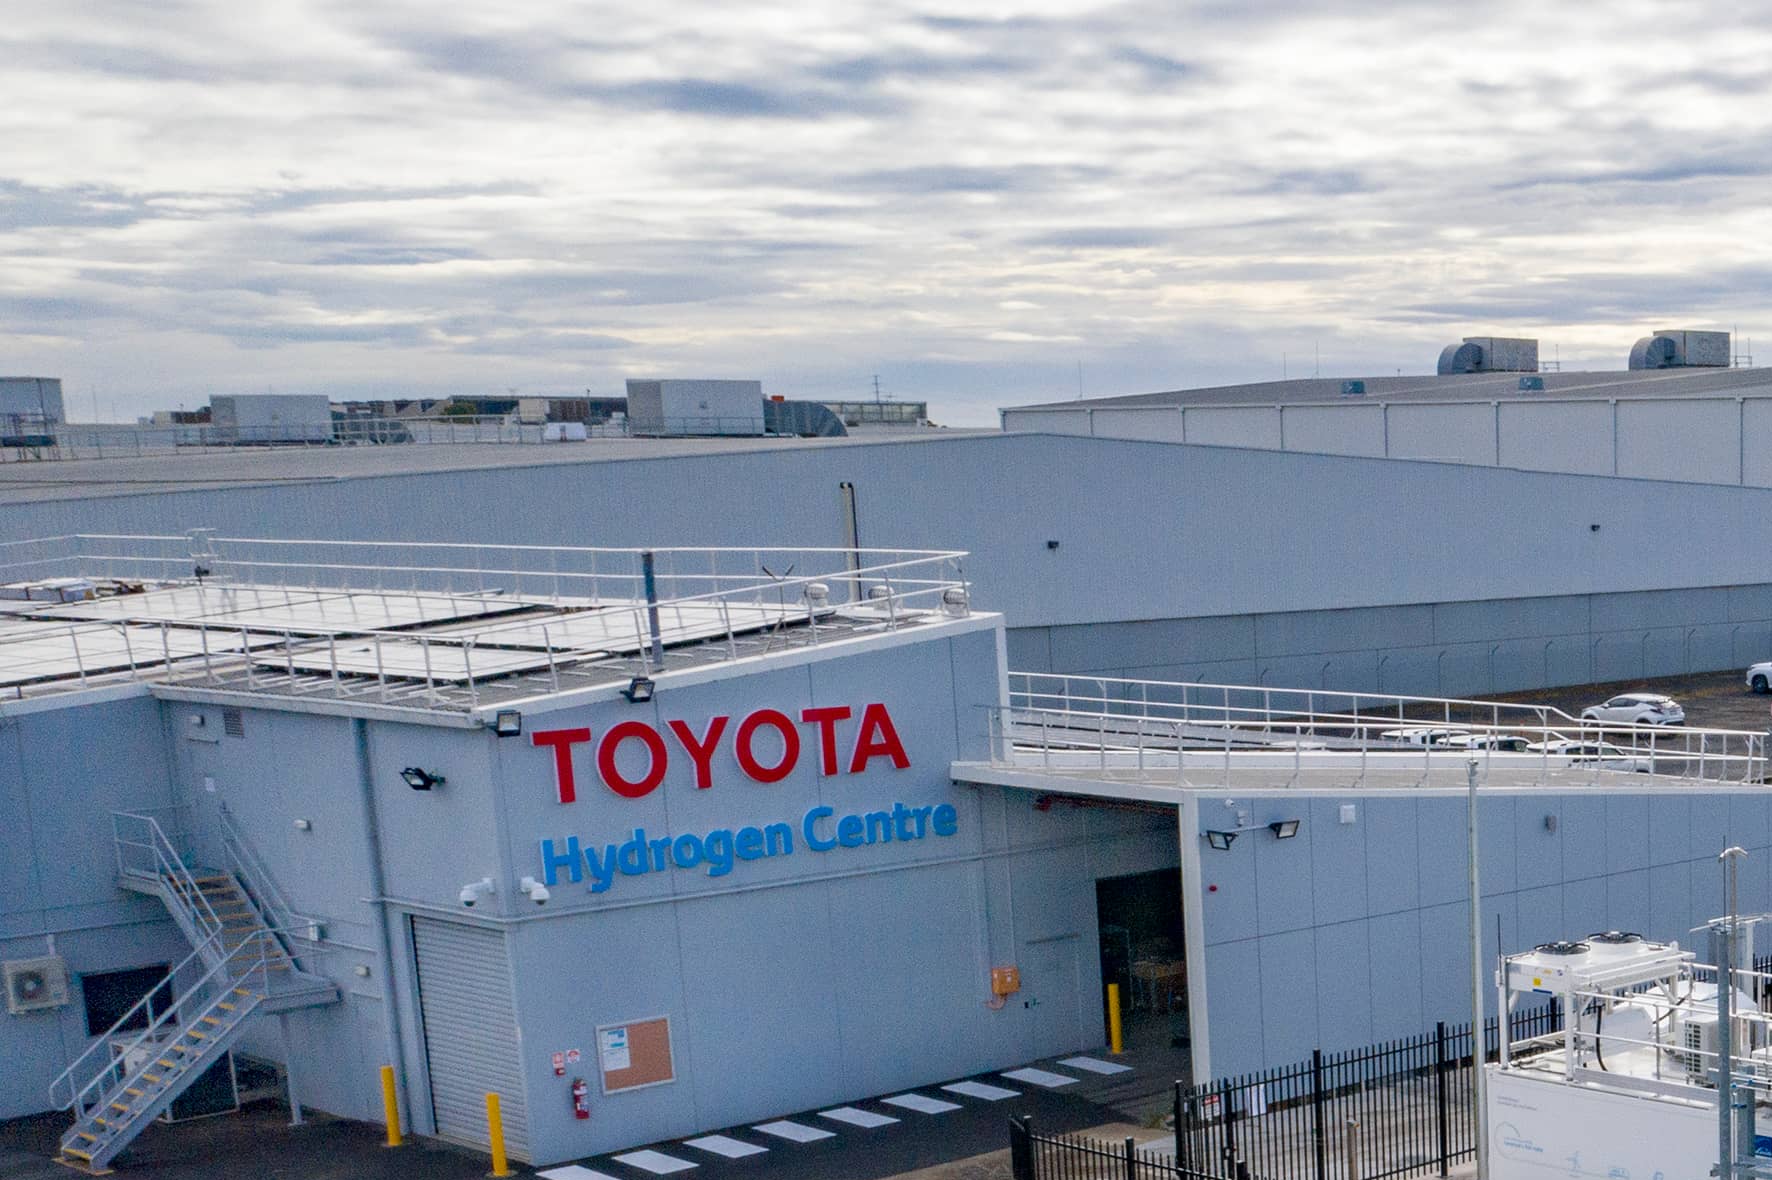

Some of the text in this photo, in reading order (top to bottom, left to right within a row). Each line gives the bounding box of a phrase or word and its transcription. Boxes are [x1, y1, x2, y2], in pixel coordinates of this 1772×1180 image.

[530, 703, 911, 804] TOYOTA
[541, 802, 958, 894] Hydrogen Centre
